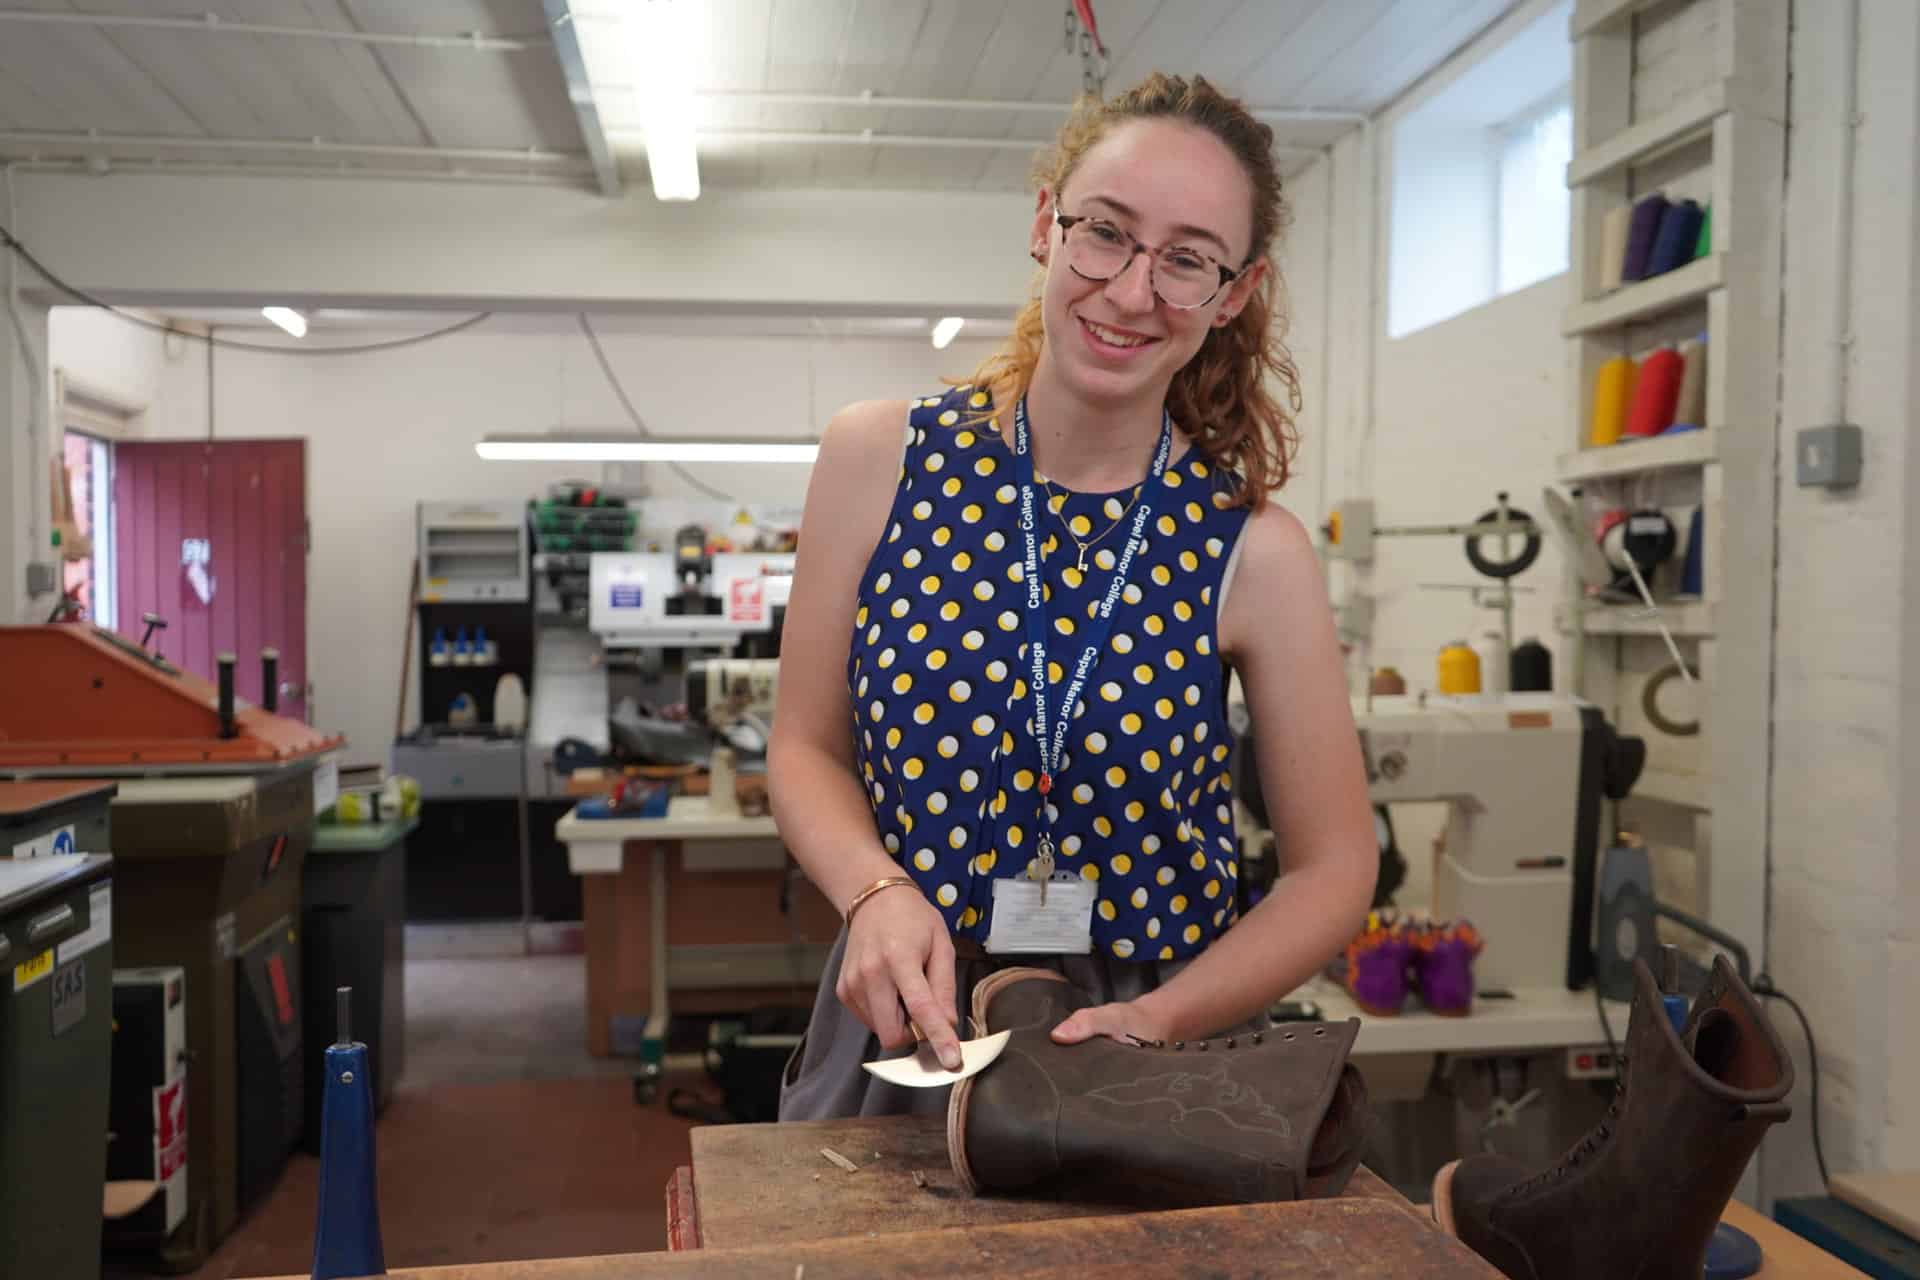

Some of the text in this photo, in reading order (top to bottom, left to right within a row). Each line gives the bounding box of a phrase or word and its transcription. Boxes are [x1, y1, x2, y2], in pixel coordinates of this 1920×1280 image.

[1016, 420, 1027, 455] Capel
[1153, 435, 1170, 477] College
[1022, 485, 1040, 609] Capel Manor College
[1101, 505, 1151, 618] Capel Manor College
[1032, 642, 1045, 690] College
[1075, 646, 1097, 679] Capel
[1035, 693, 1047, 734] Manor
[1060, 680, 1083, 720] Manor
